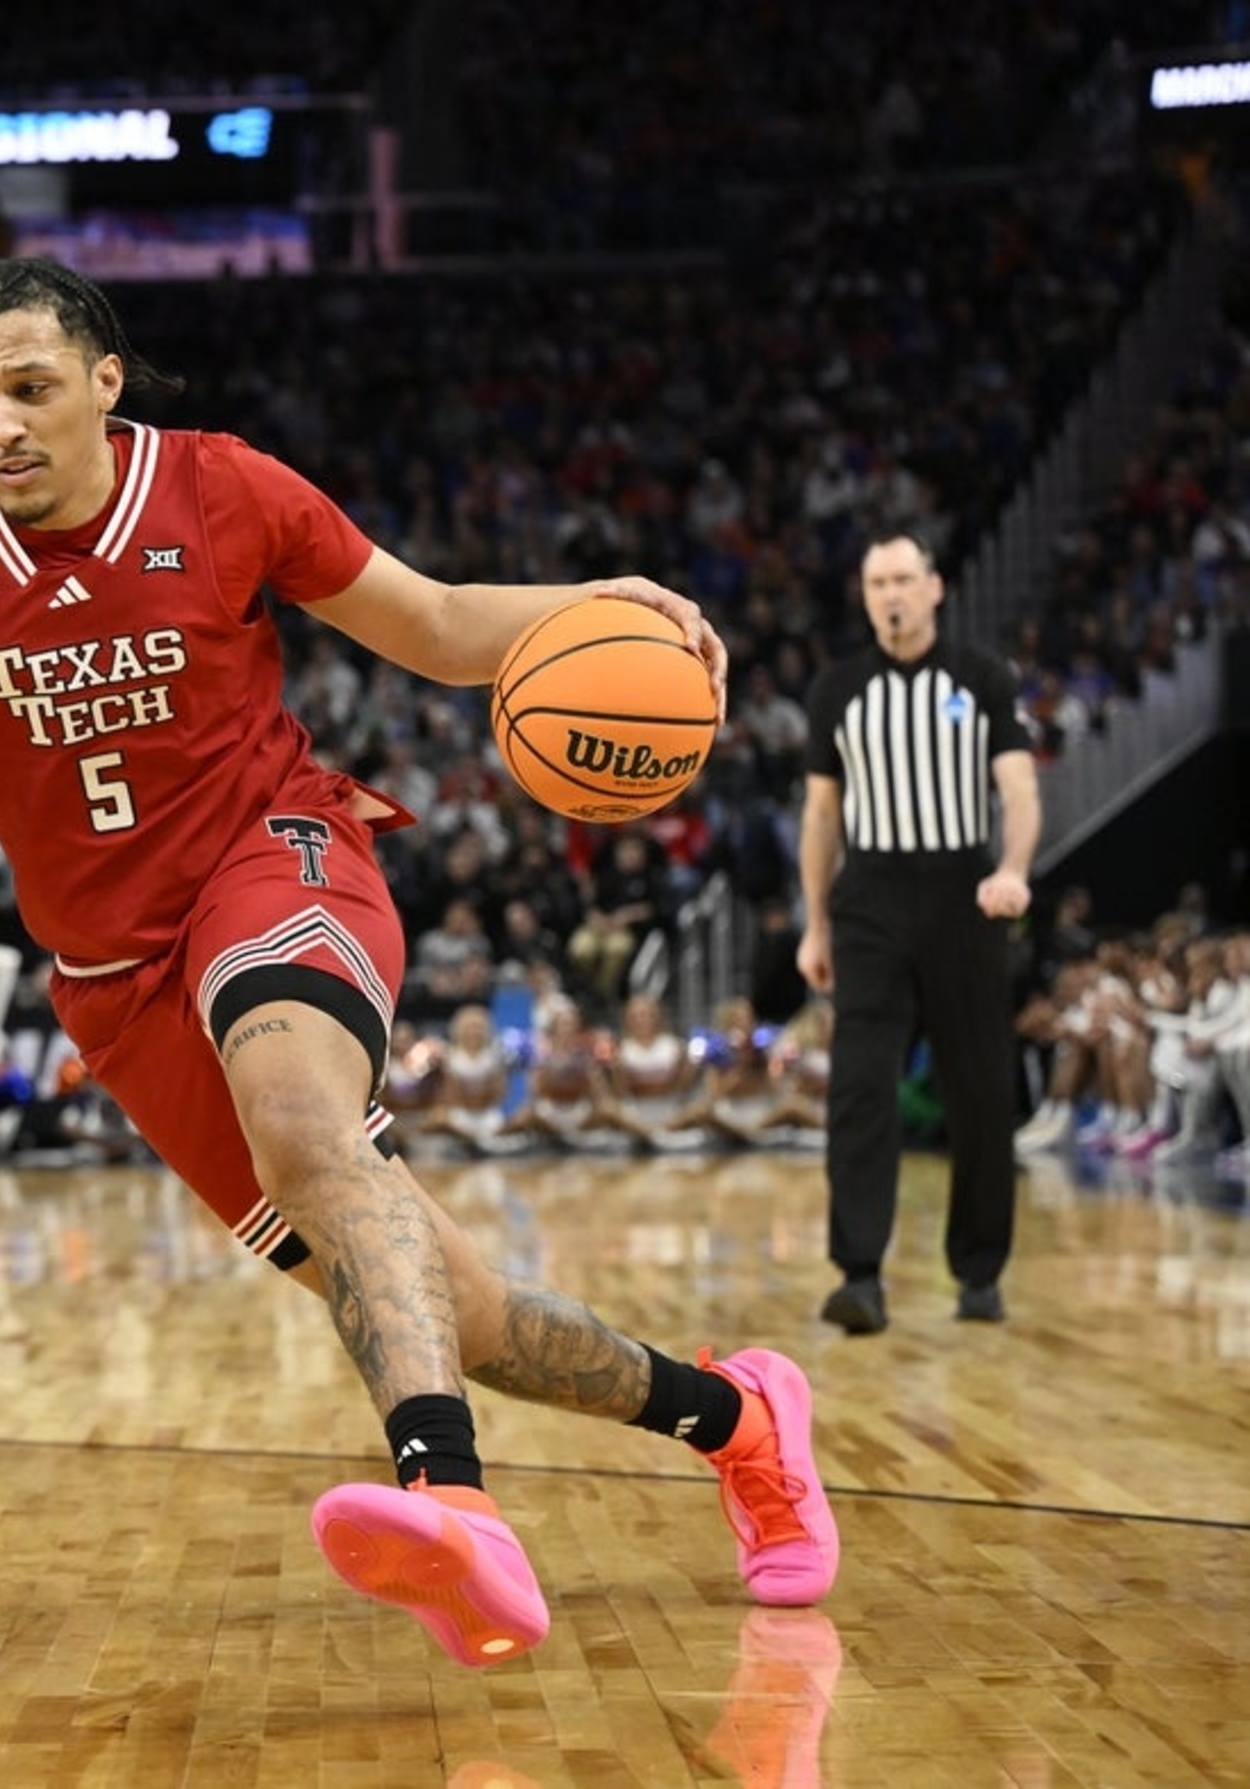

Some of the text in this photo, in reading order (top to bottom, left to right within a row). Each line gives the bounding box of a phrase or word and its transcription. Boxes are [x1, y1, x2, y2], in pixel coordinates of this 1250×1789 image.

[7, 684, 175, 746] TECH
[566, 729, 701, 780] Wilson
[78, 751, 136, 832] 5
